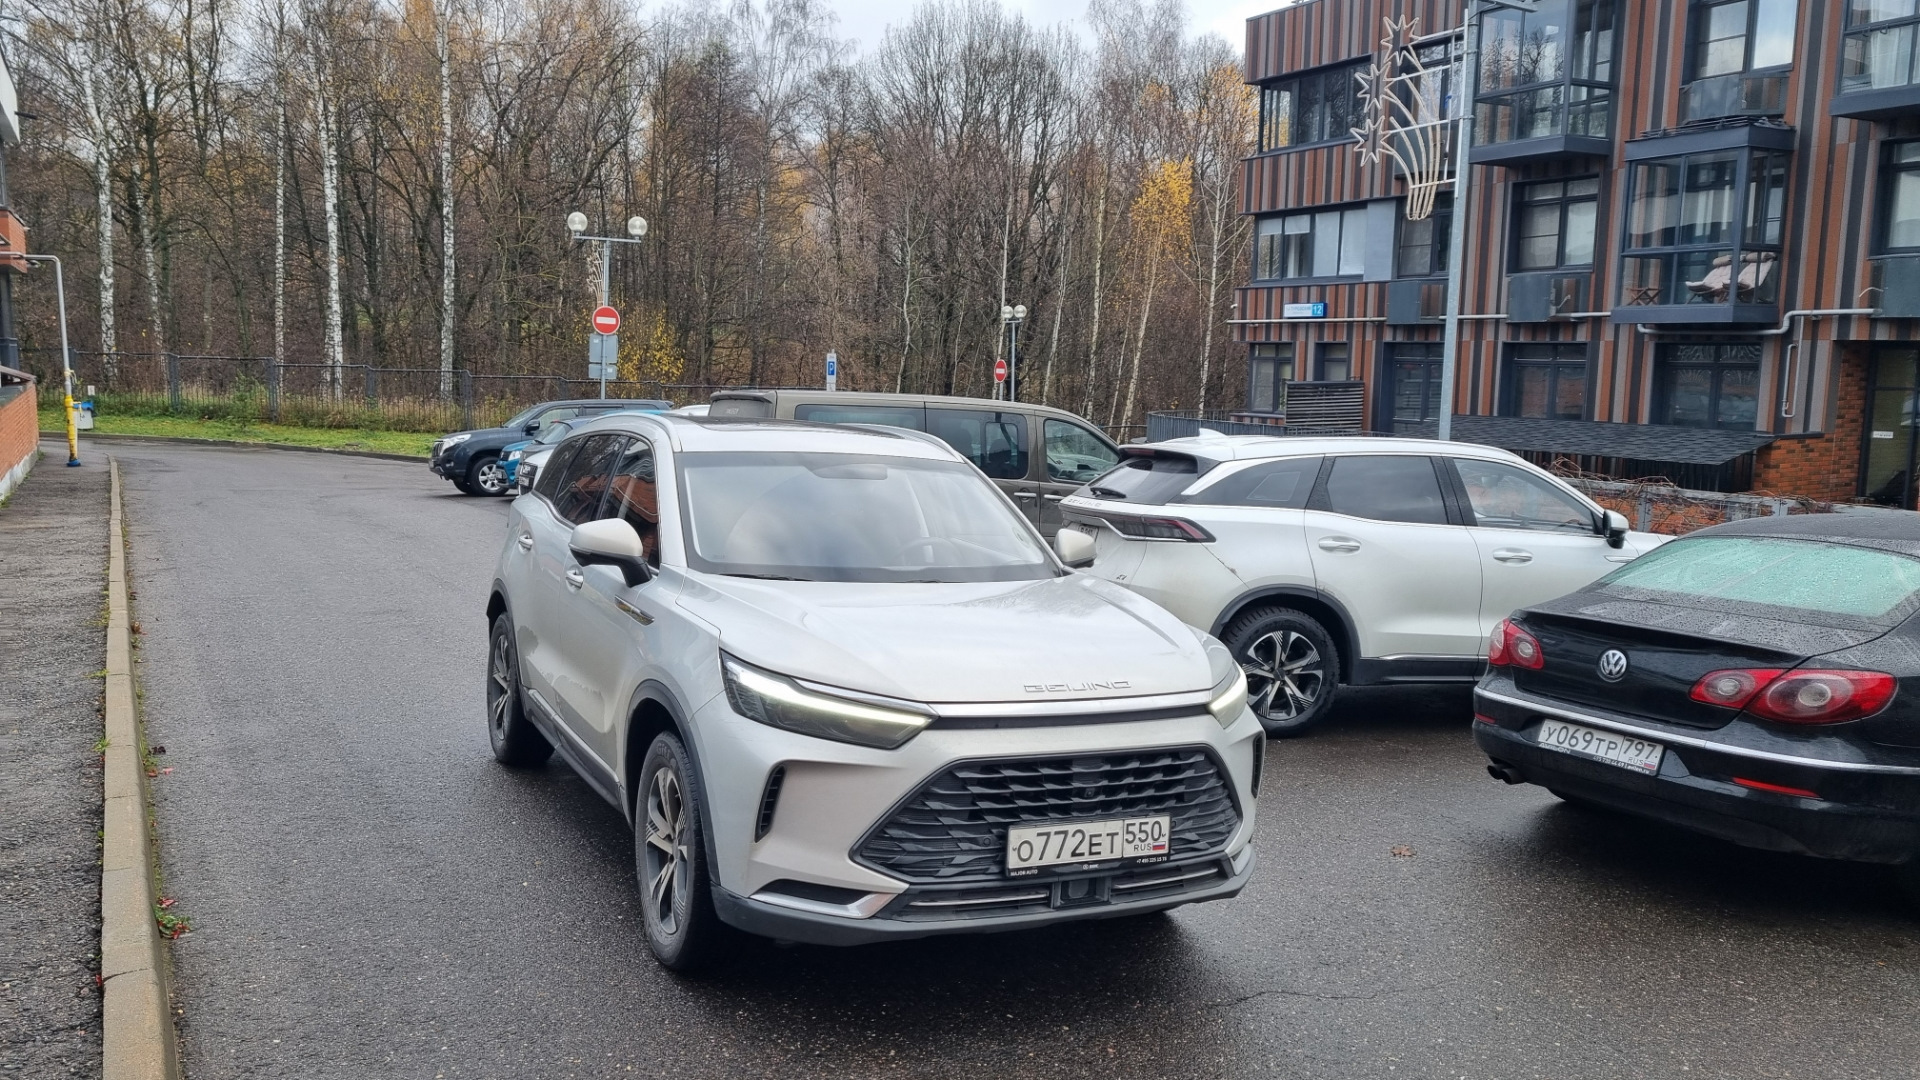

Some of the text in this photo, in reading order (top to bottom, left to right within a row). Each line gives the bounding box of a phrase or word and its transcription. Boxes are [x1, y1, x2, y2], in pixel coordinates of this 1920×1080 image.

[1314, 305, 1322, 314] 12
[1023, 680, 1132, 693] BEIJING
[1624, 738, 1657, 760] 797
[1628, 756, 1644, 765] RUS
[1125, 820, 1163, 844] 550
[1133, 842, 1152, 852] RUS
